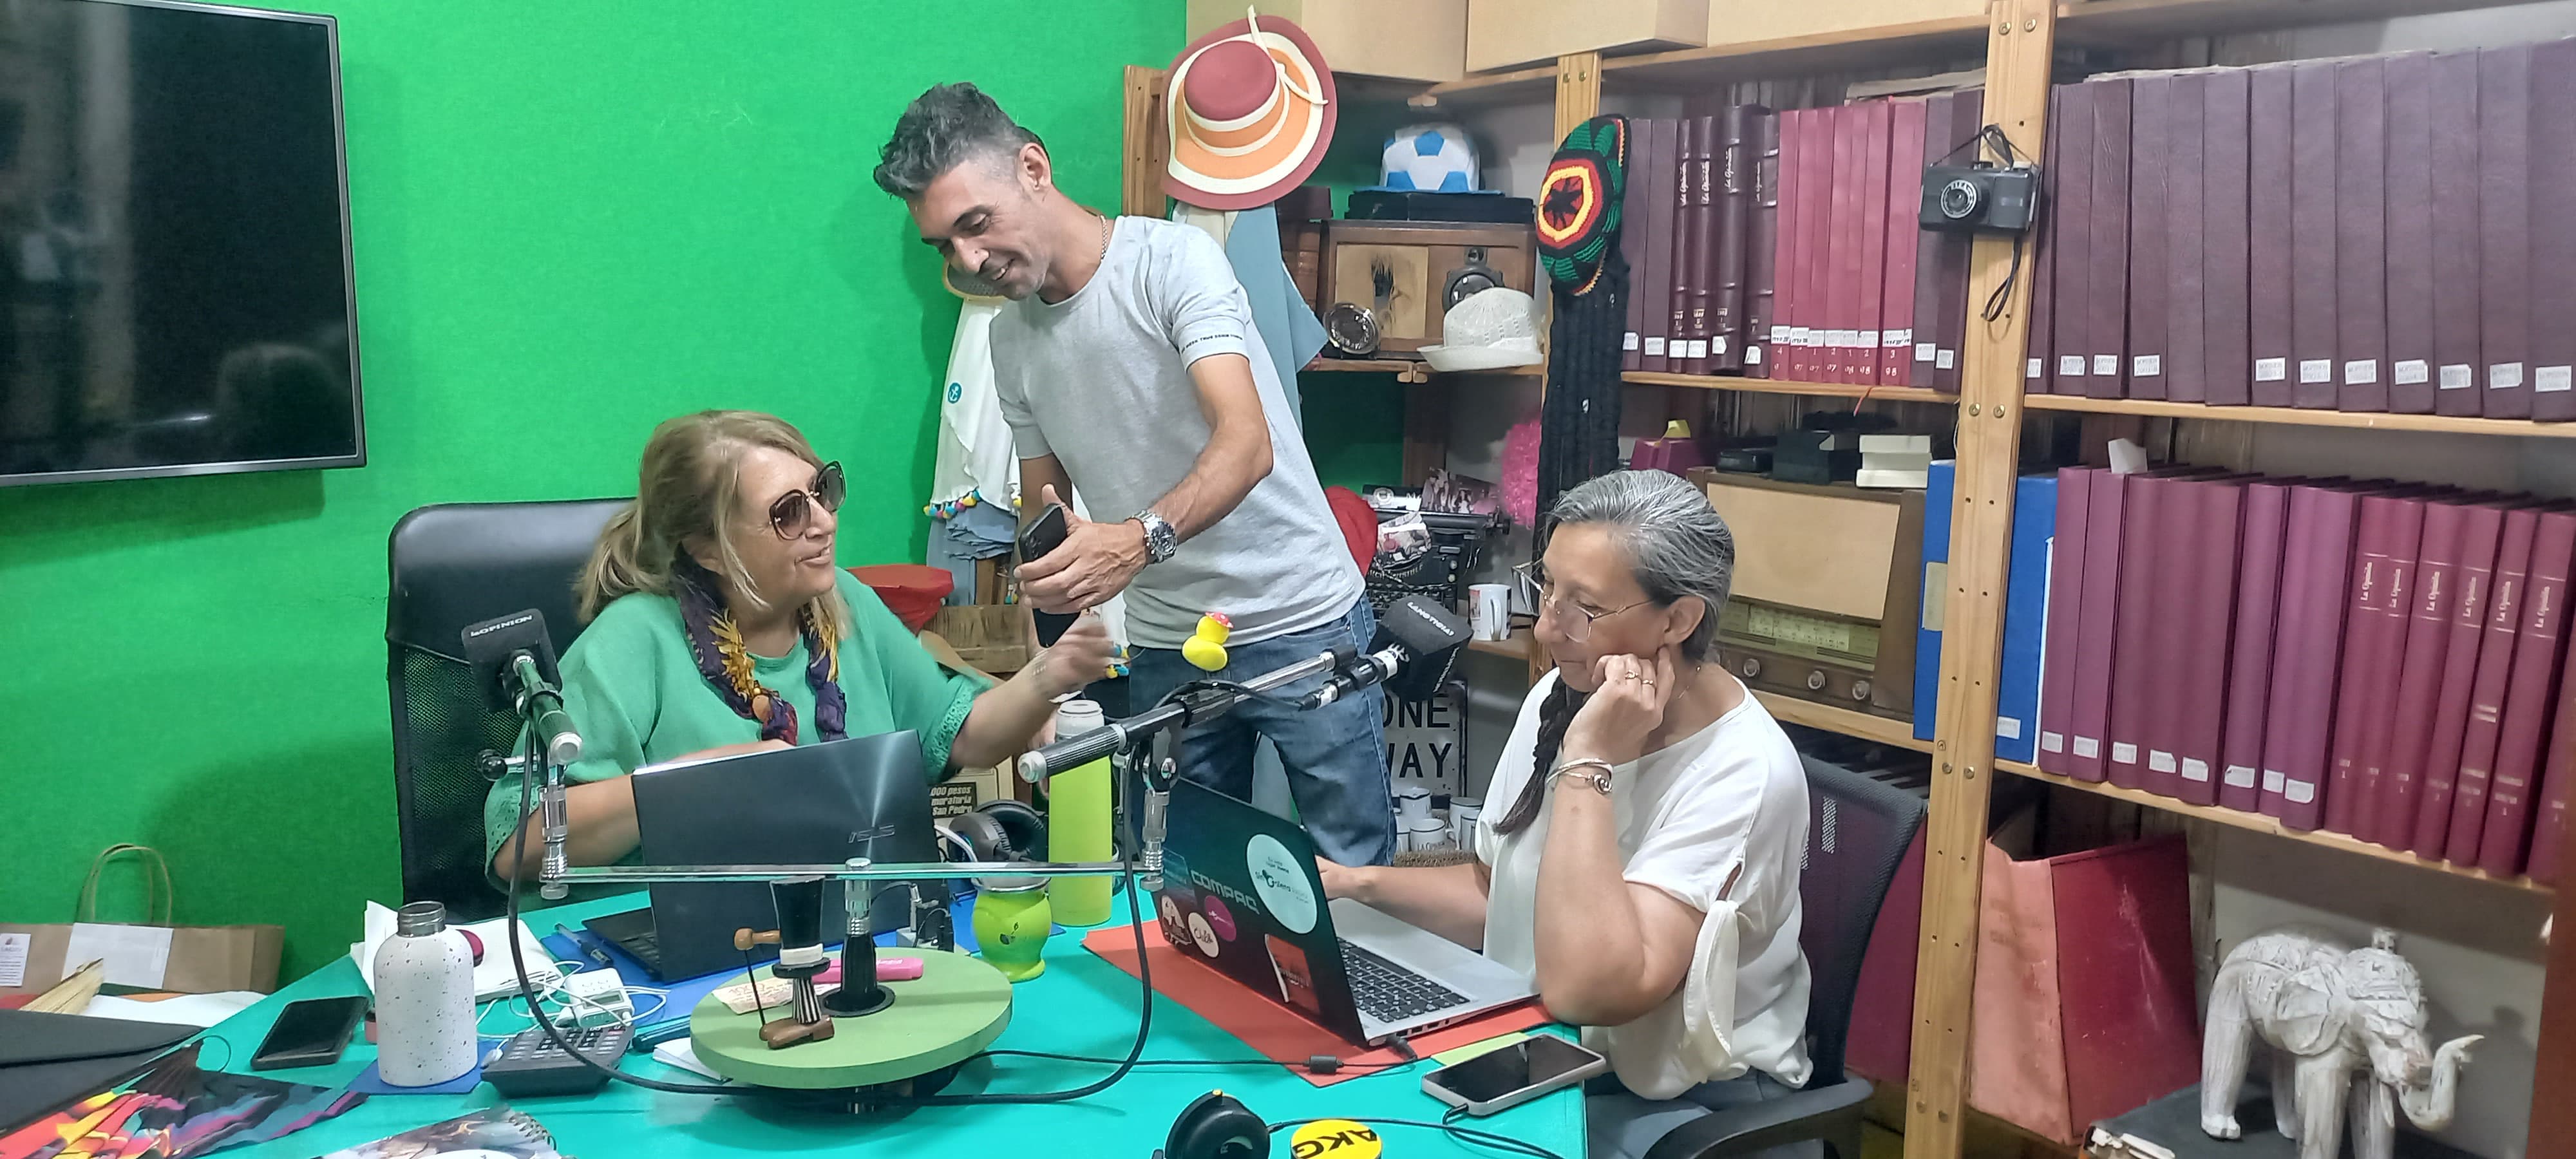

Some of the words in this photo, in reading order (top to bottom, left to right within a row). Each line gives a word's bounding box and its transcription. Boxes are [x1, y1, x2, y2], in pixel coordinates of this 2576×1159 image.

[1890, 350, 1895, 359] 3
[947, 787, 972, 797] pesos
[932, 806, 947, 816] San
[948, 805, 972, 815] Pedro
[1190, 869, 1260, 915] COMPAQ
[1293, 1128, 1378, 1159] AKG
